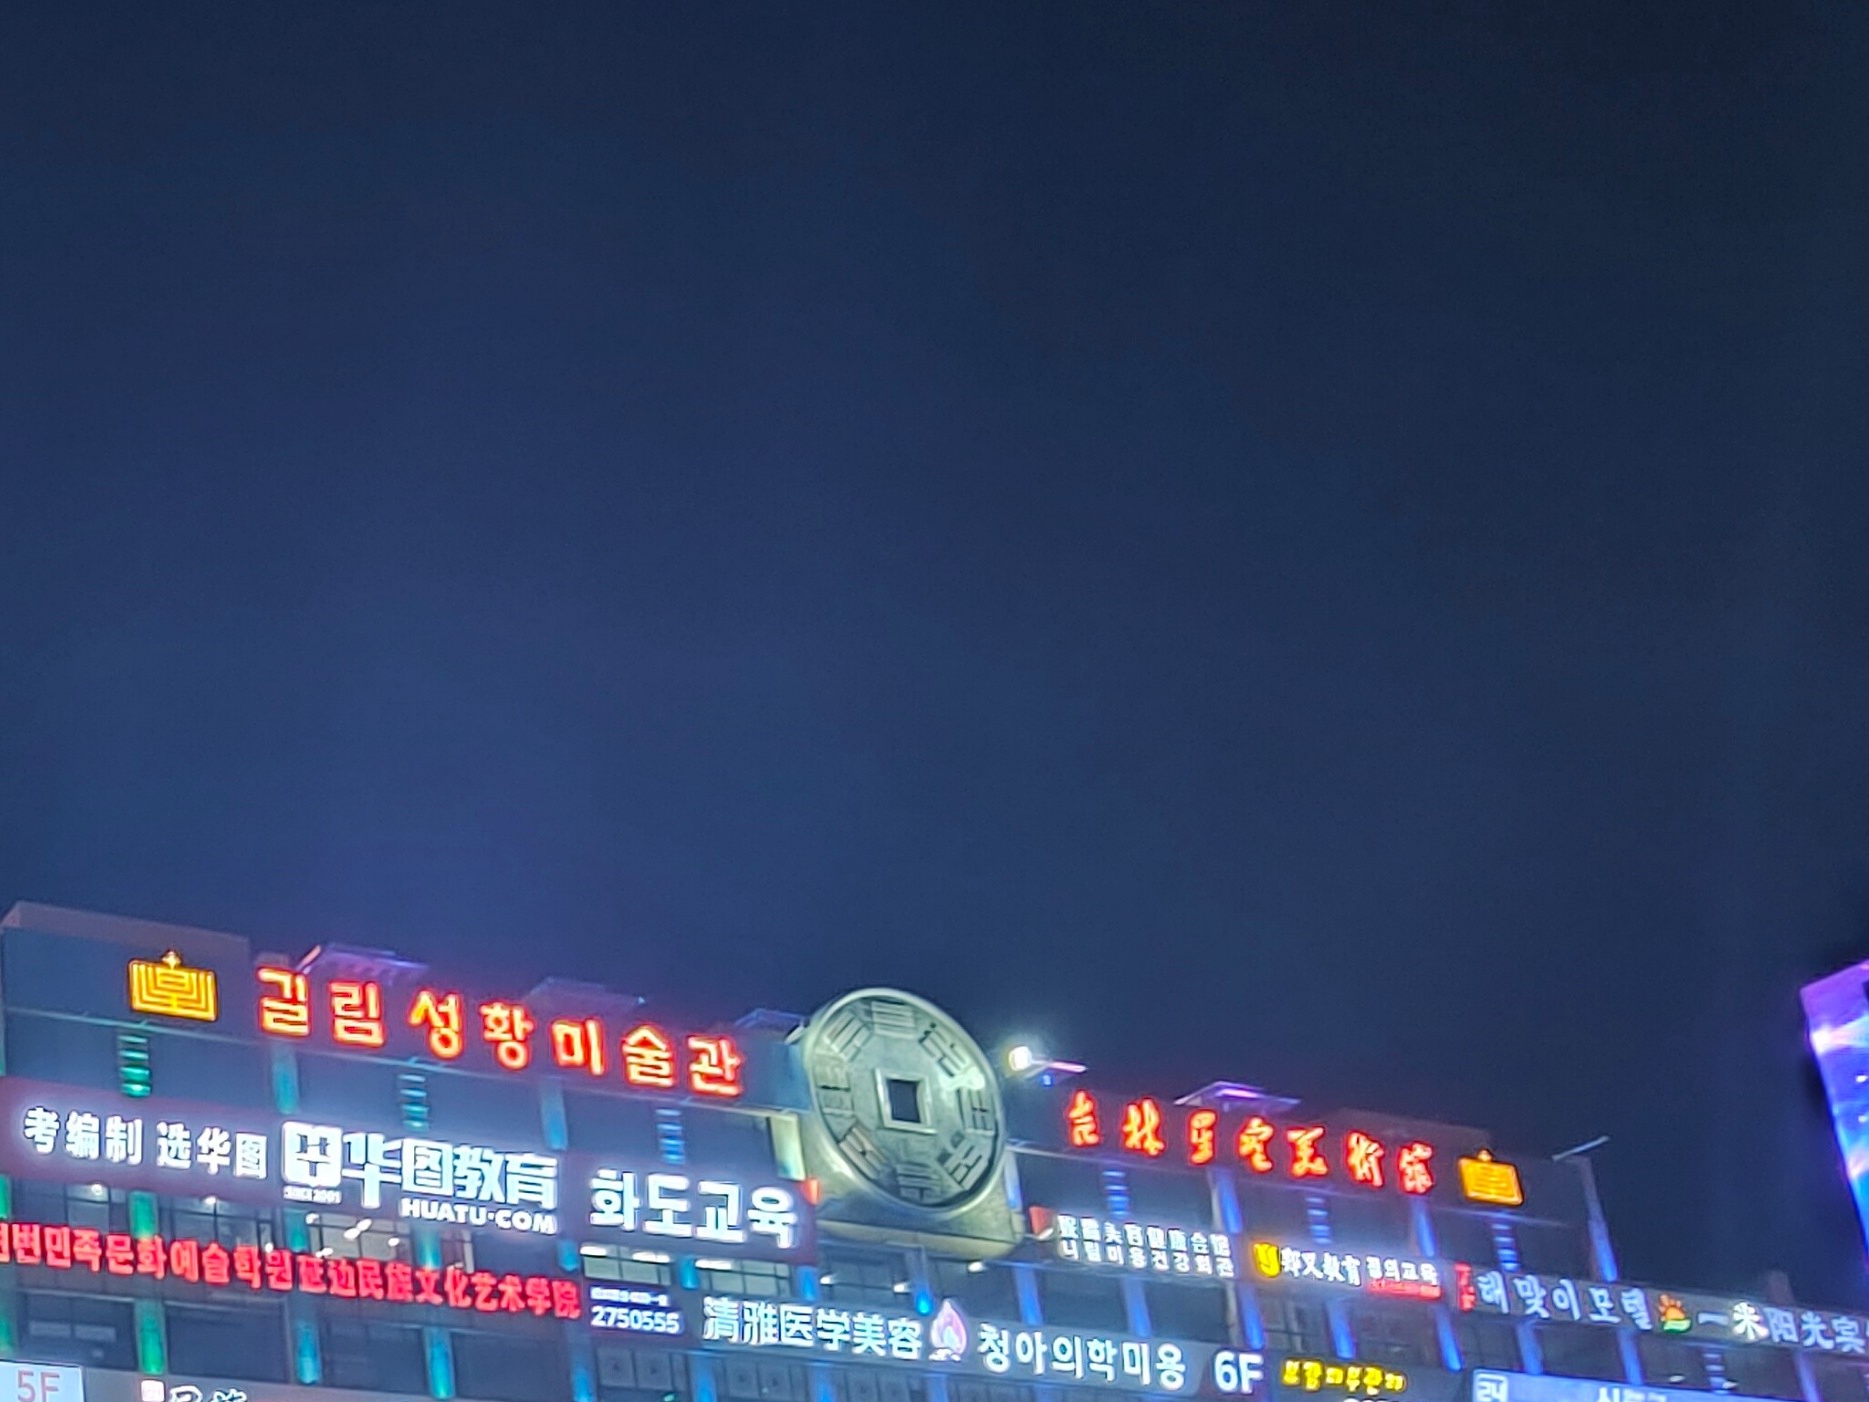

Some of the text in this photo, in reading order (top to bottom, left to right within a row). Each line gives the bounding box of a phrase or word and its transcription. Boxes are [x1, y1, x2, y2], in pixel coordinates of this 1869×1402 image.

[23, 1106, 268, 1180] 考编制 选华图
[342, 1130, 558, 1210] 华图教育
[590, 1168, 799, 1250] 화도교육
[296, 1252, 582, 1321] 延边民族文化艺术学院
[591, 1305, 681, 1335] 2750555
[702, 1296, 923, 1360] 清雅医学美容
[977, 1320, 1265, 1395] 청아의학미용 6F
[1697, 1300, 1869, 1354] 一米阳光宾
